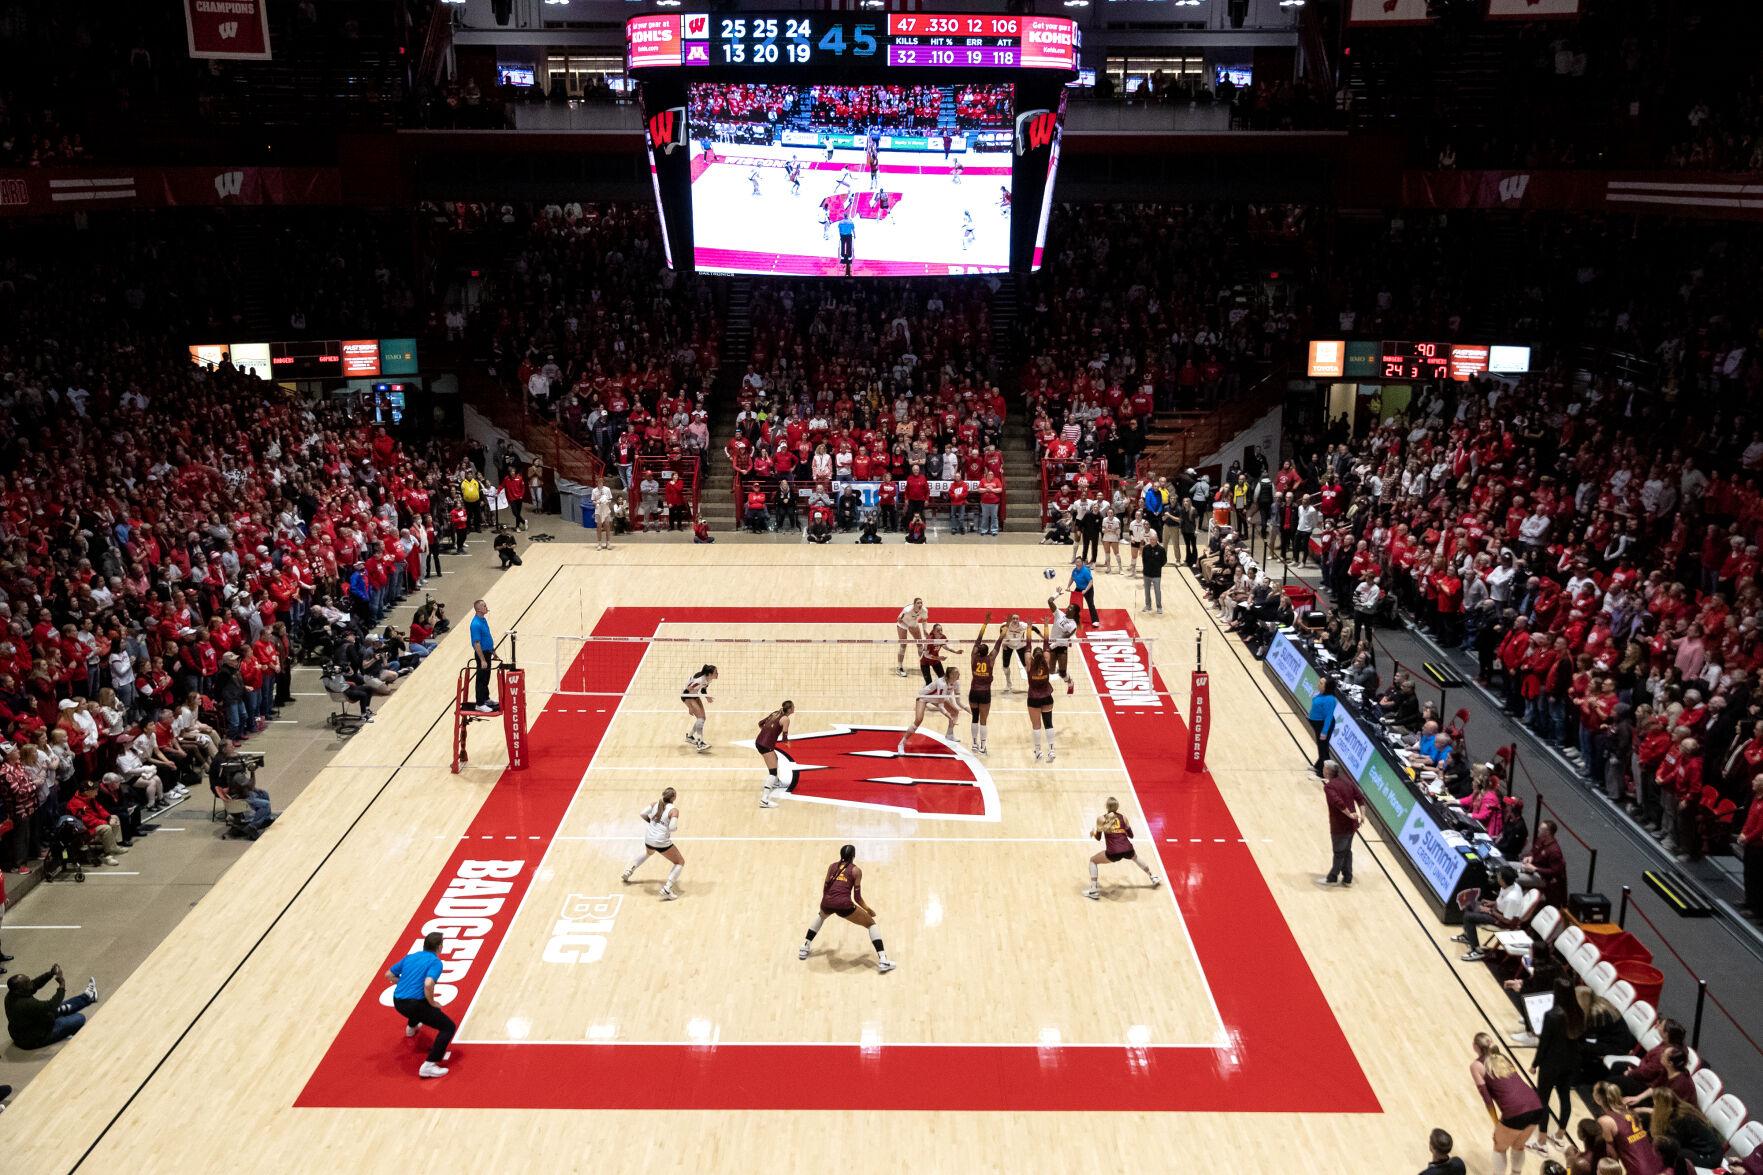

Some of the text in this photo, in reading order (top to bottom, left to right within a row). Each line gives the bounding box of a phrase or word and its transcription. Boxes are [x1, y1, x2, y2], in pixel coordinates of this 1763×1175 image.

[195, 1, 255, 15] CHAMPIONS
[663, 20, 670, 28] at
[721, 19, 812, 38] 25 25 24
[897, 18, 1018, 33] 47 .330 12 106
[1032, 21, 1045, 29] Get
[632, 29, 673, 43] KOHL'S
[818, 23, 877, 56] 4 5
[895, 37, 1013, 47] KILLS HIT % ERR ATT
[722, 44, 811, 63] 13 20 19
[897, 50, 1014, 65] 32 .110 19 118
[385, 353, 402, 361] BMO
[1312, 364, 1339, 372] TOYOTA
[1385, 363, 1403, 377] 24
[1411, 367, 1418, 378] 3
[1434, 366, 1447, 379] 17
[975, 662, 987, 673] 20
[1085, 629, 1164, 707] WISCONSIN
[1280, 646, 1303, 676] summit
[510, 687, 521, 768] WISCONSIN
[1193, 696, 1204, 761] BADGERS
[1341, 723, 1368, 761] summit
[1421, 830, 1459, 880] summit
[1416, 846, 1450, 892] CREDIT UNION
